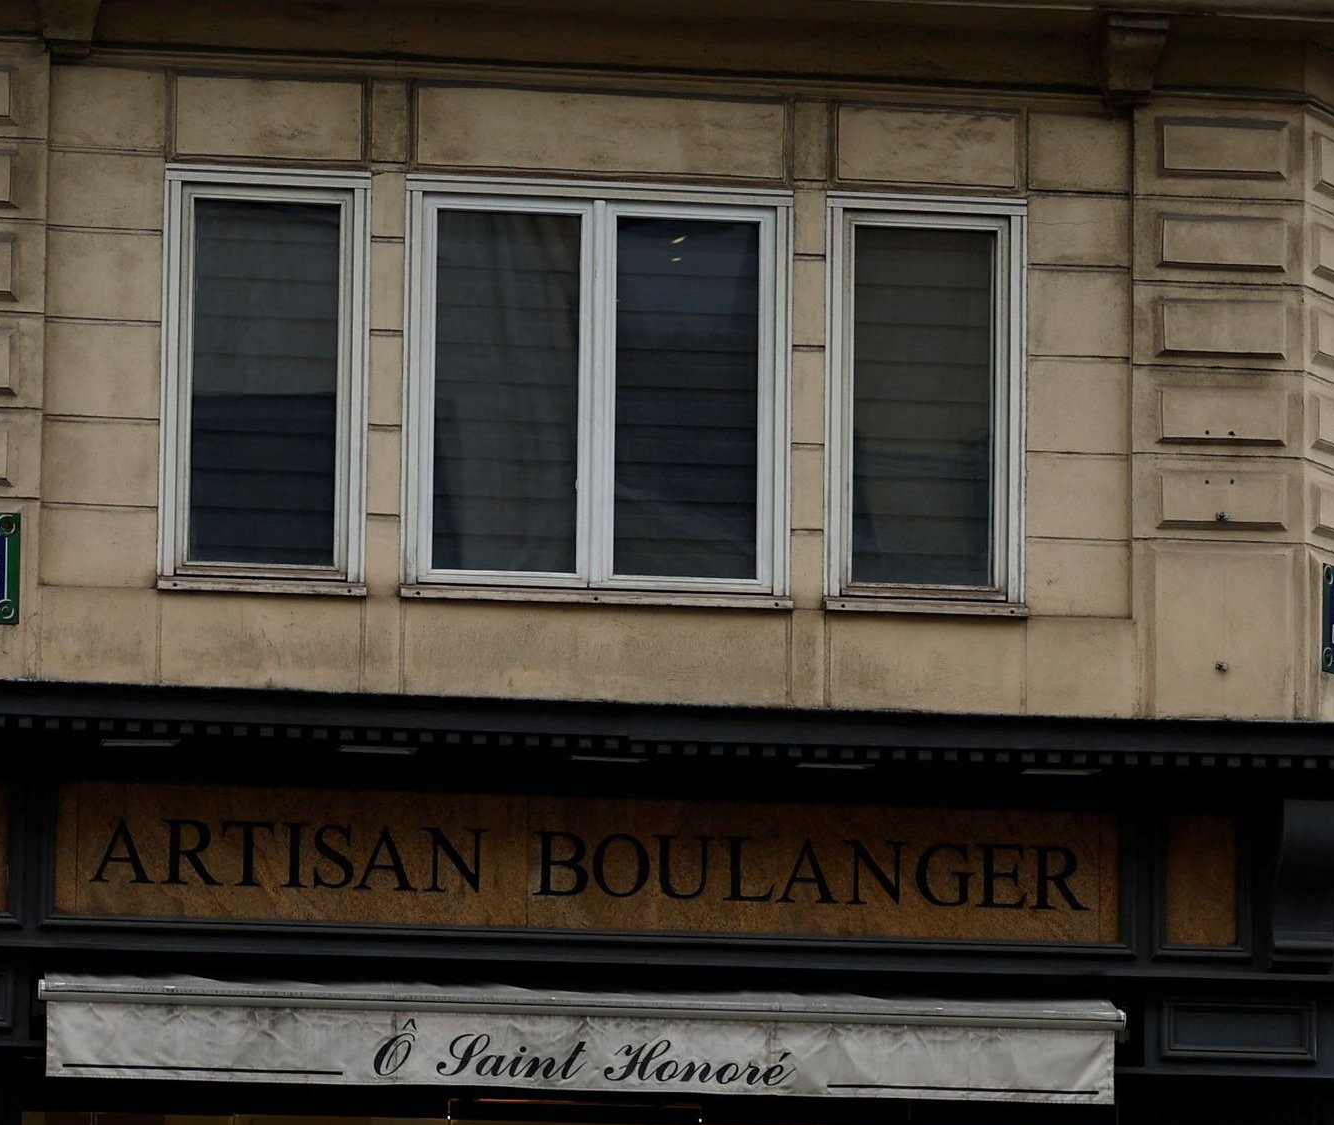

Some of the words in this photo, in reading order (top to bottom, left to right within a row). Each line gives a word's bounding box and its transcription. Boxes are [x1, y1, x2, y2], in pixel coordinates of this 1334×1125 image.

[90, 818, 488, 893] ARTISAN
[533, 829, 1090, 911] BOULANGER
[372, 1018, 419, 1077] Ô
[435, 1031, 588, 1081] Saint
[604, 1038, 798, 1088] Honoré
